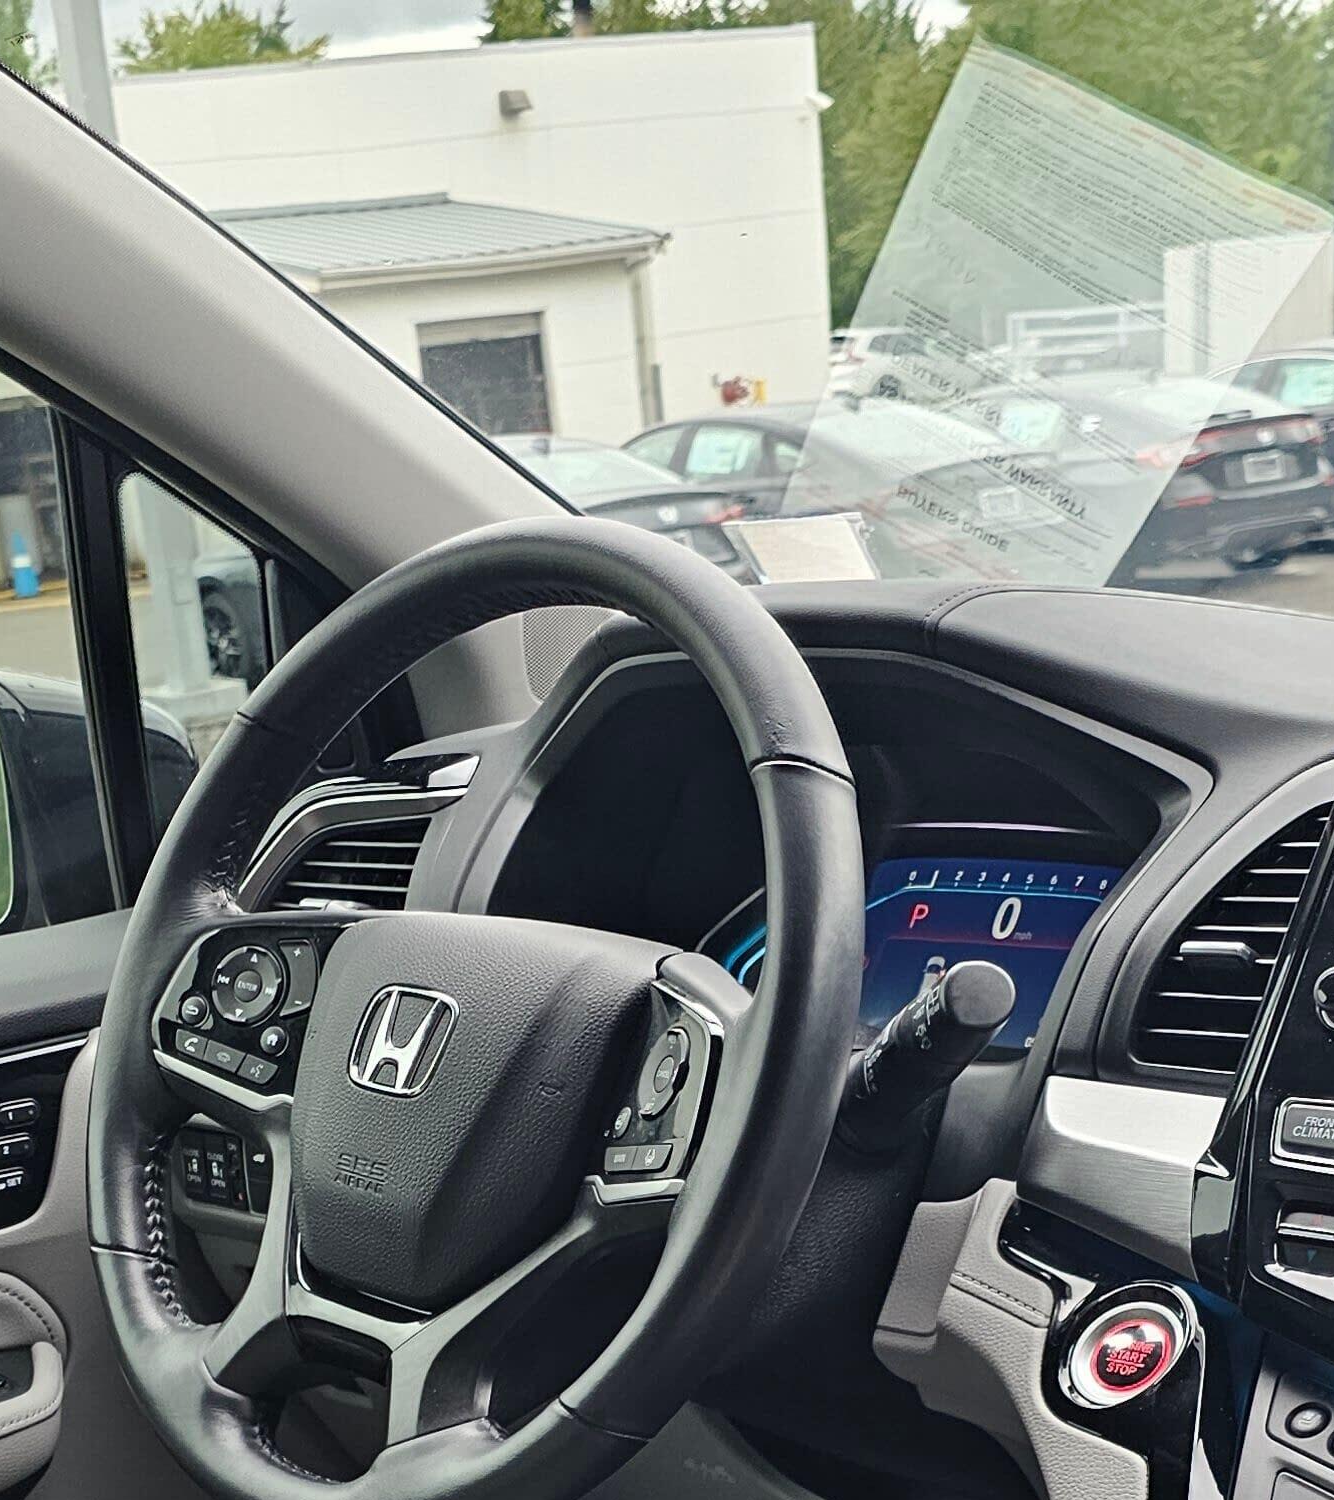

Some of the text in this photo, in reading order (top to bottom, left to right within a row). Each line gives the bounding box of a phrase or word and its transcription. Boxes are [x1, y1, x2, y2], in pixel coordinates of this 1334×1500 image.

[909, 870, 1108, 890] 0 2 3 4 5 6 7 8
[908, 904, 929, 929] P
[991, 896, 1022, 940] 0
[1109, 1350, 1147, 1363] START
[1106, 1362, 1138, 1376] STOP
